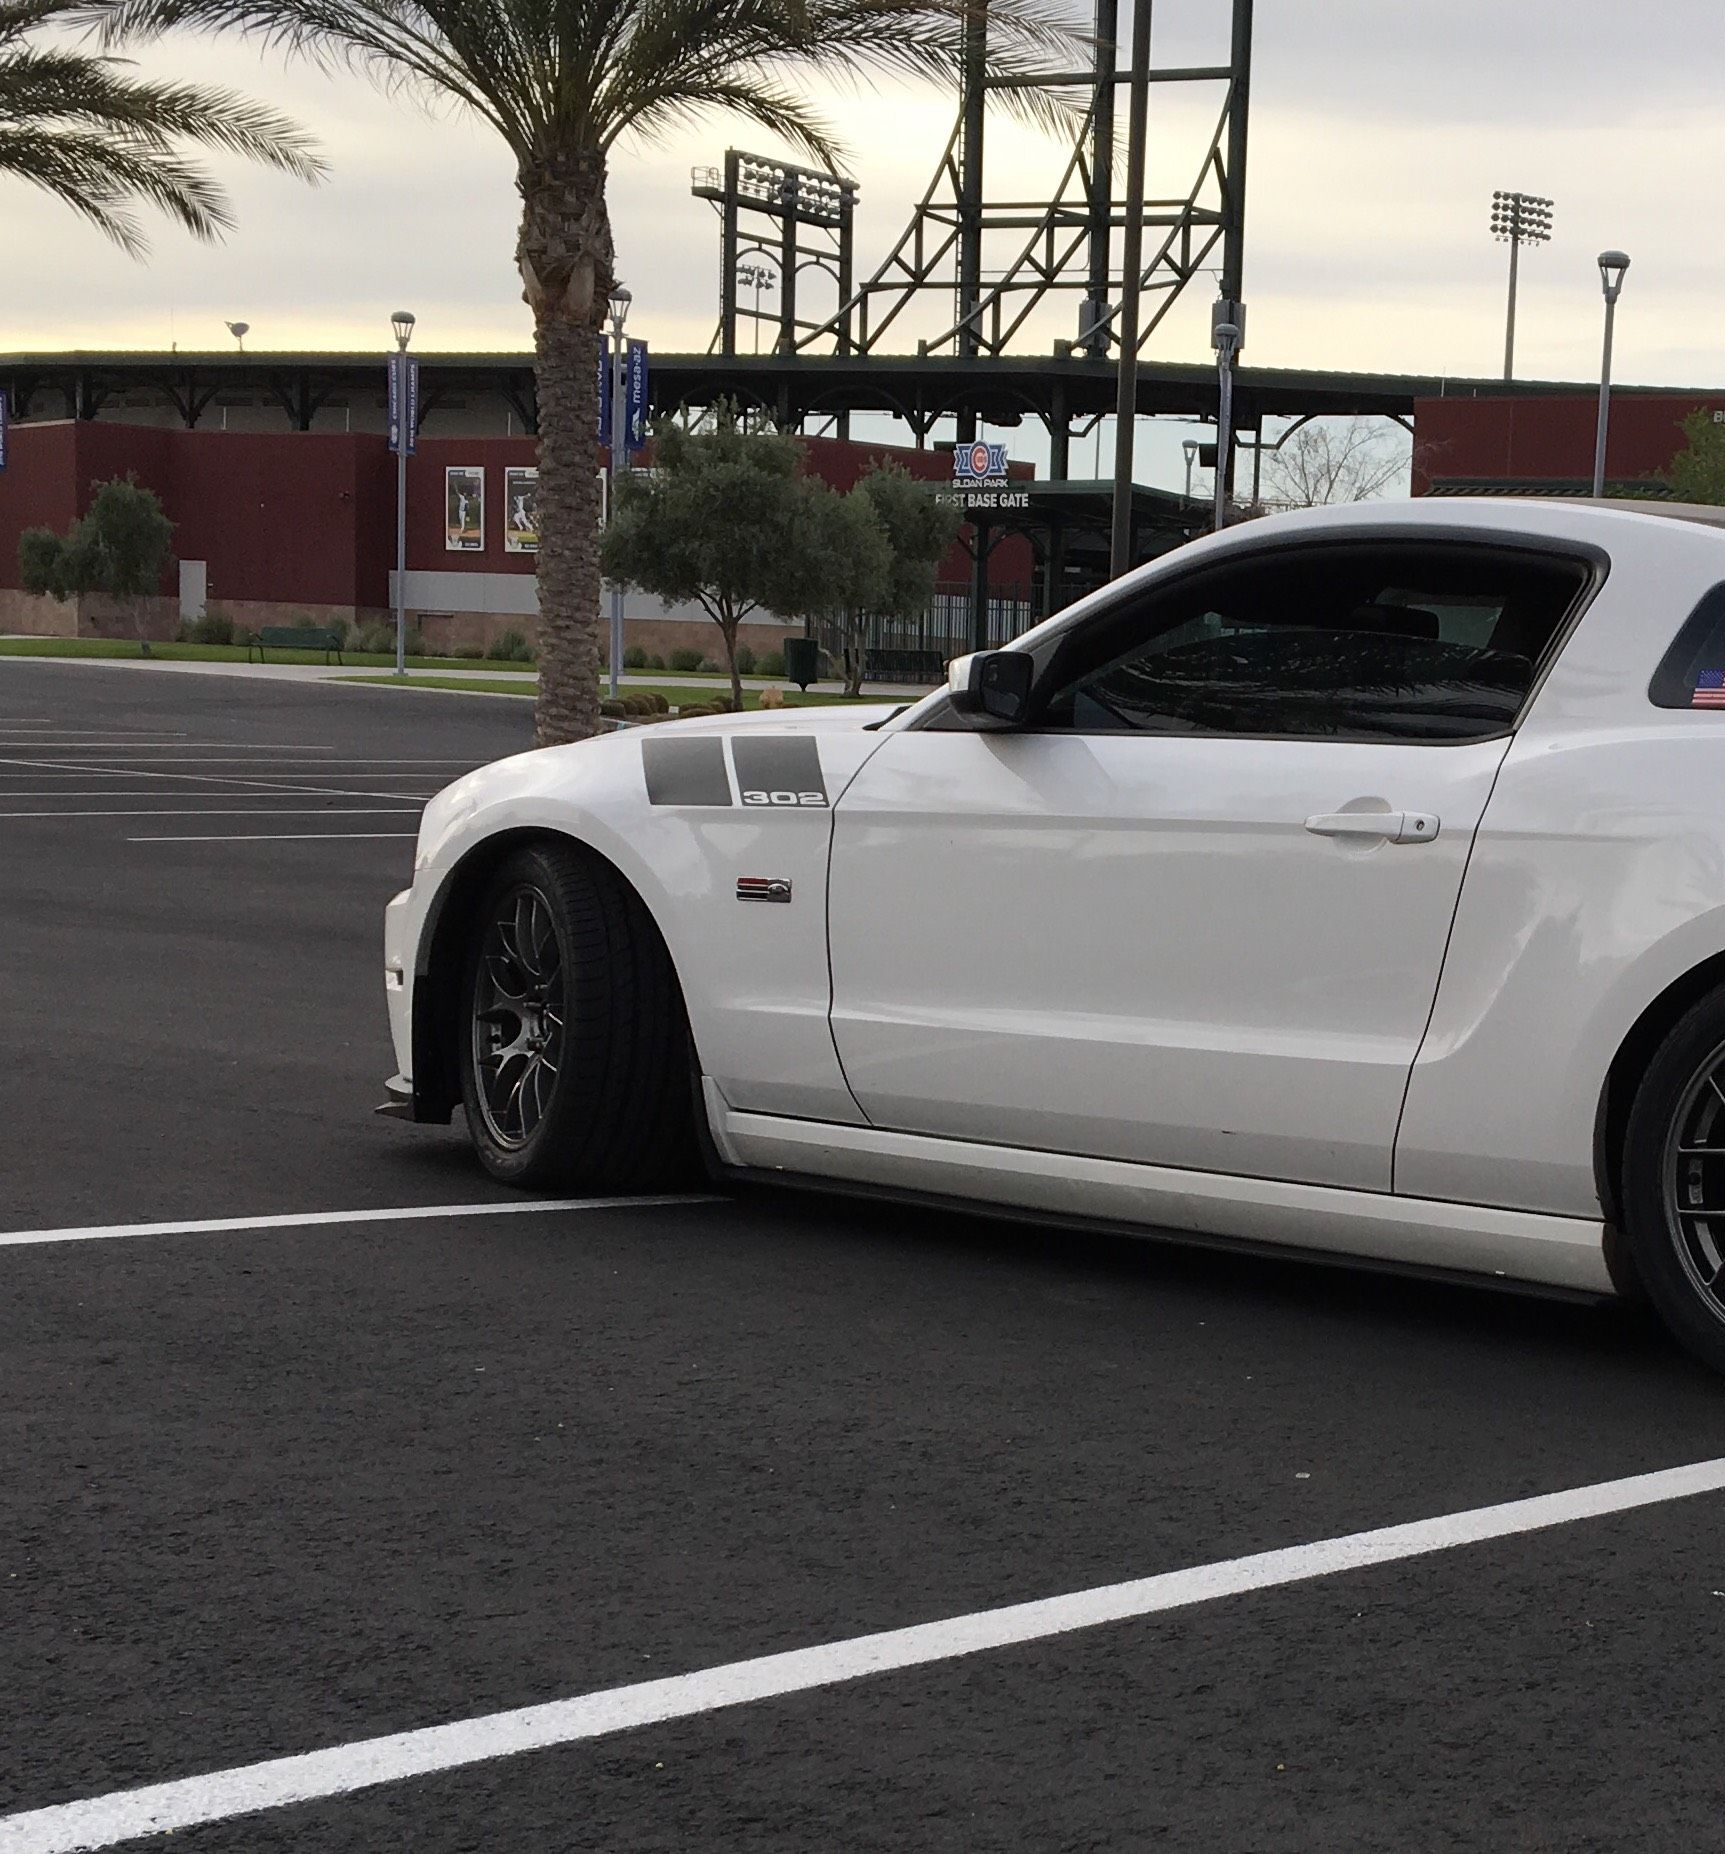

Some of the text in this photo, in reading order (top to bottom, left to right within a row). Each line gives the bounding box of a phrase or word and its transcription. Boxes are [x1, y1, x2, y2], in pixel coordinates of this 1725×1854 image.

[952, 479, 1008, 488] SLOAN PARK
[967, 493, 997, 507] BASE
[1000, 493, 1029, 507] GATE
[743, 790, 827, 805] 302
